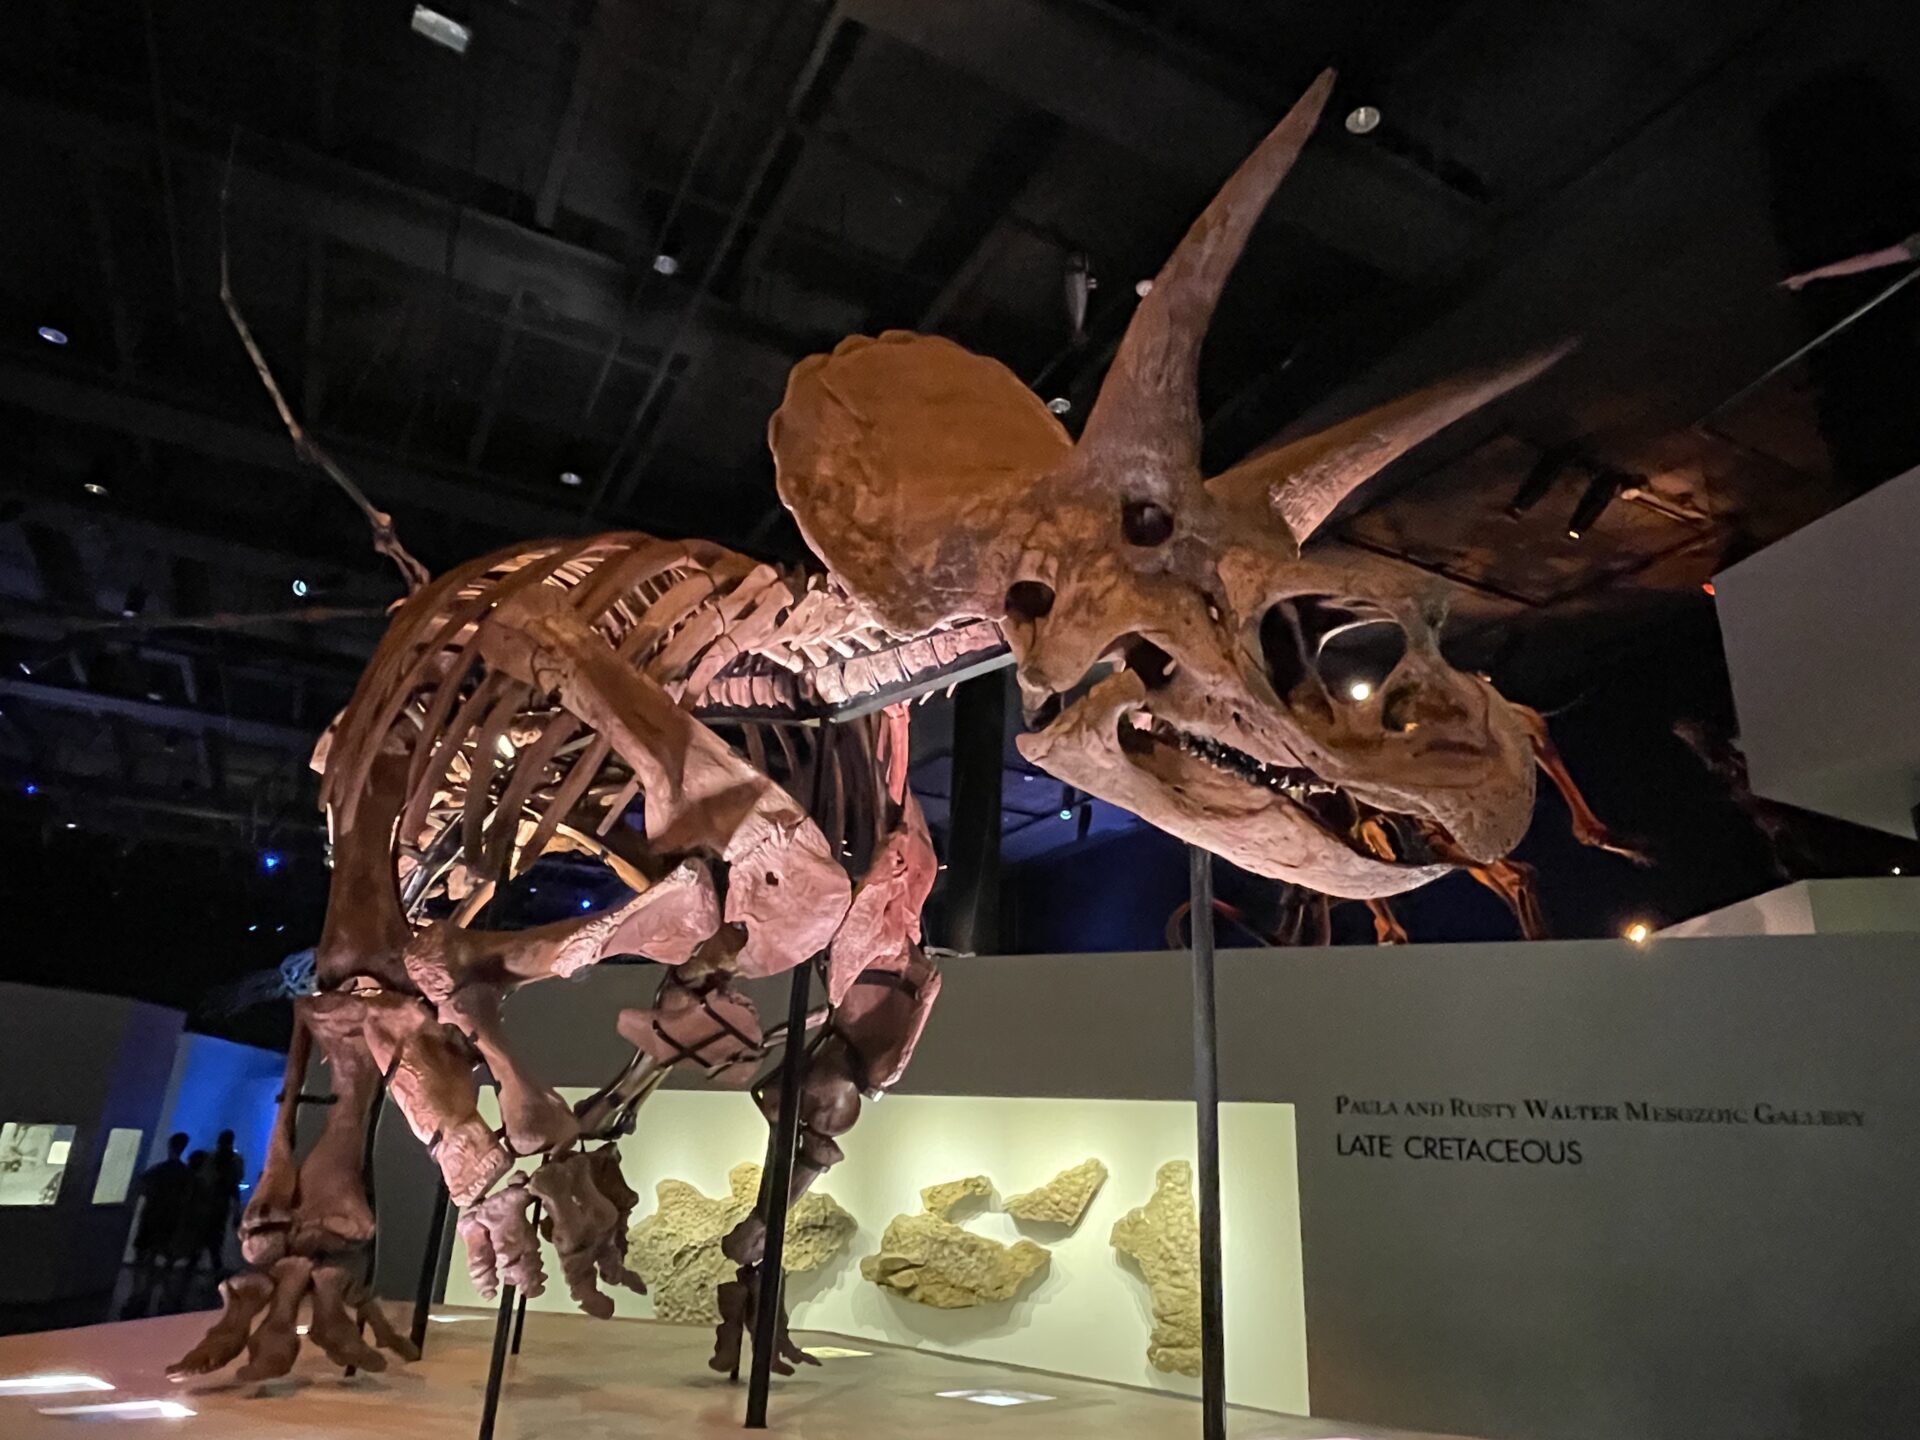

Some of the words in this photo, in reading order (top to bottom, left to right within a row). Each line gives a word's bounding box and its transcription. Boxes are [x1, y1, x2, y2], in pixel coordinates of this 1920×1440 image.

[1336, 1095, 1398, 1116] PAULA
[1404, 1099, 1443, 1116] AND
[1450, 1097, 1517, 1118] RUSTY
[1523, 1099, 1618, 1121] WALTER
[1624, 1100, 1748, 1124] MESOZOIC
[1753, 1103, 1866, 1127] GALLERY
[1336, 1134, 1392, 1158] LATE
[1404, 1136, 1583, 1165] CRETACEOUS
